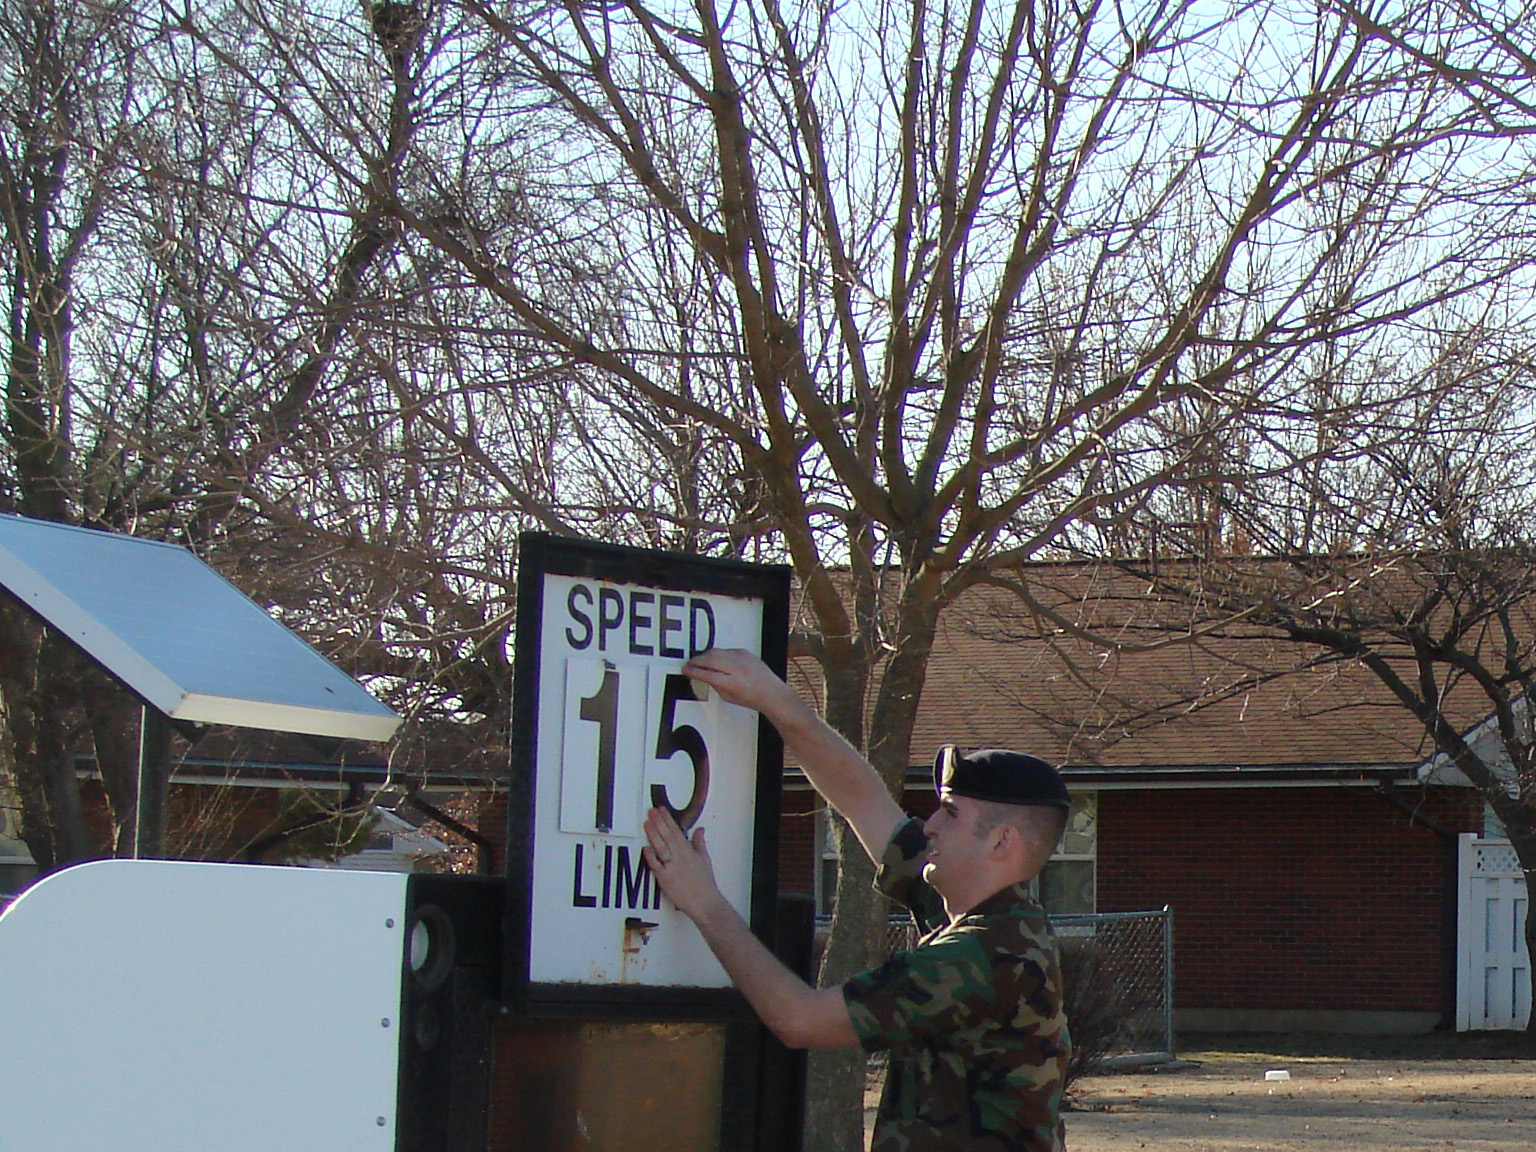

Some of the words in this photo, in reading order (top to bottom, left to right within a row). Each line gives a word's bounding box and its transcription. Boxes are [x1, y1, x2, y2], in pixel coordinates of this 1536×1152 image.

[566, 584, 715, 657] SPEED
[580, 671, 710, 837] 15
[572, 843, 680, 910] LIM
